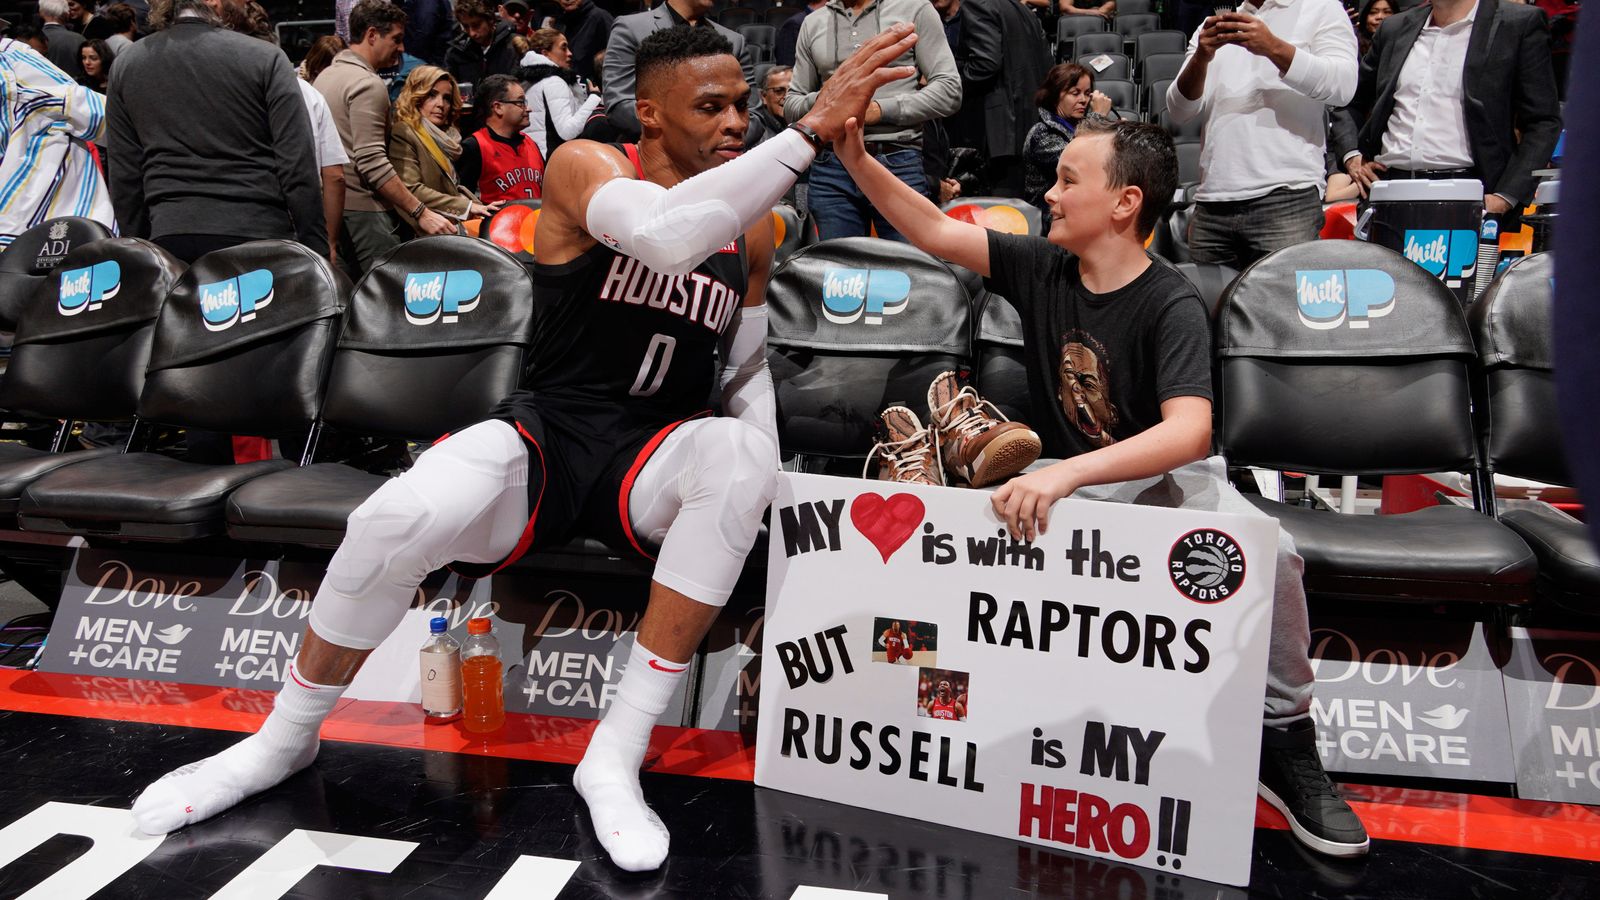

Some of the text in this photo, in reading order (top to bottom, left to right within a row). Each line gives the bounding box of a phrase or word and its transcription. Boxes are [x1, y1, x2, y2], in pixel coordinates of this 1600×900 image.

[495, 167, 542, 192] RAPTOR
[38, 240, 71, 257] ADI
[600, 256, 740, 336] HOUSTON
[628, 333, 677, 397] 0
[779, 498, 1141, 582] MY is with the
[1184, 533, 1243, 573] TORONTO
[84, 560, 201, 611] Dove
[228, 570, 313, 619] Dov
[1172, 561, 1229, 600] RAPTORS
[75, 616, 153, 645] MEN
[417, 586, 500, 631] ove
[533, 589, 638, 642] Dov
[220, 627, 299, 657] MEN
[967, 591, 1212, 674] RAPTORS
[69, 643, 181, 673] +CARE
[214, 655, 291, 683] +CA
[528, 650, 614, 681] MEN
[775, 624, 854, 690] BUT
[1310, 628, 1458, 688] Dove
[1310, 697, 1413, 730] MEN
[780, 708, 984, 793] RUSSELL
[1031, 721, 1166, 786] is MY
